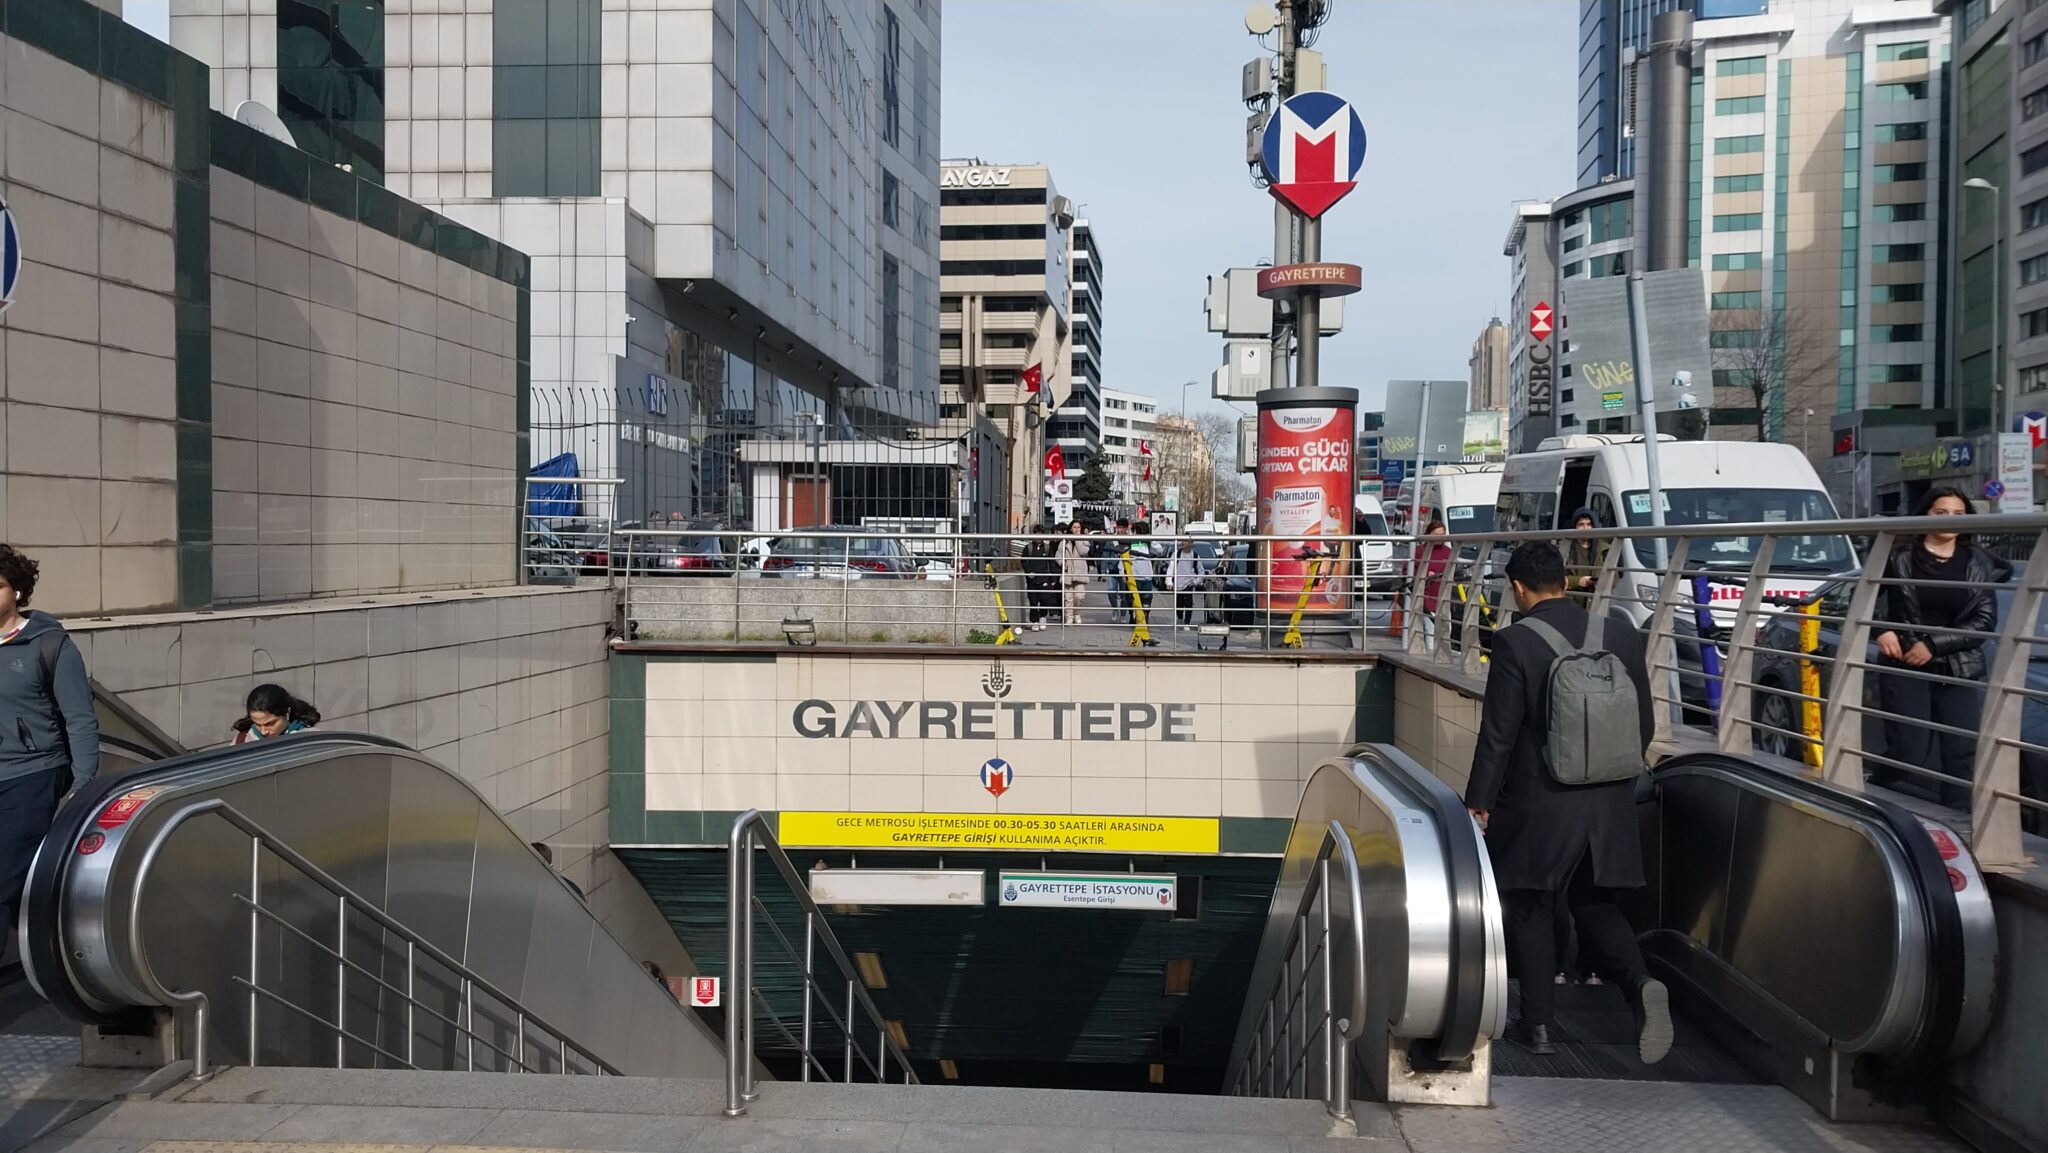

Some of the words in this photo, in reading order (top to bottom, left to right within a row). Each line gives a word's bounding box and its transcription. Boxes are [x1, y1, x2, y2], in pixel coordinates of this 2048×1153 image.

[941, 168, 1012, 187] AYGAZ
[1269, 267, 1345, 284] GAYRETTEPE
[1528, 344, 1552, 417] HSBC
[1283, 416, 1322, 425] Pharmaton
[1260, 446, 1299, 458] ÇİNDEKİ
[1302, 438, 1349, 457] GÜCÜ
[1260, 462, 1294, 472] ORTAYA
[1298, 457, 1348, 475] ÇIKAR
[1274, 490, 1320, 502] Pharmaton
[793, 699, 1196, 741] GAYRETTEPE
[836, 817, 862, 827] GECE
[865, 818, 916, 828] METROSU
[918, 817, 991, 830] İŞLETMESİNDE
[993, 819, 1056, 830] 00.30-05.30
[1059, 820, 1107, 831] SAATLERİ
[1109, 821, 1165, 832] ARASINDA
[892, 832, 960, 843] GAYRETTEPE
[964, 832, 997, 845] GİRİŞİ
[999, 834, 1061, 844] KULLANIMA
[1064, 835, 1107, 847] AÇIKTIR.
[1019, 883, 1087, 894] GAYRETTEPE
[1092, 883, 1154, 896] İSTASYONU
[1063, 895, 1096, 904] Esentepe
[1097, 896, 1116, 905] Girişi
